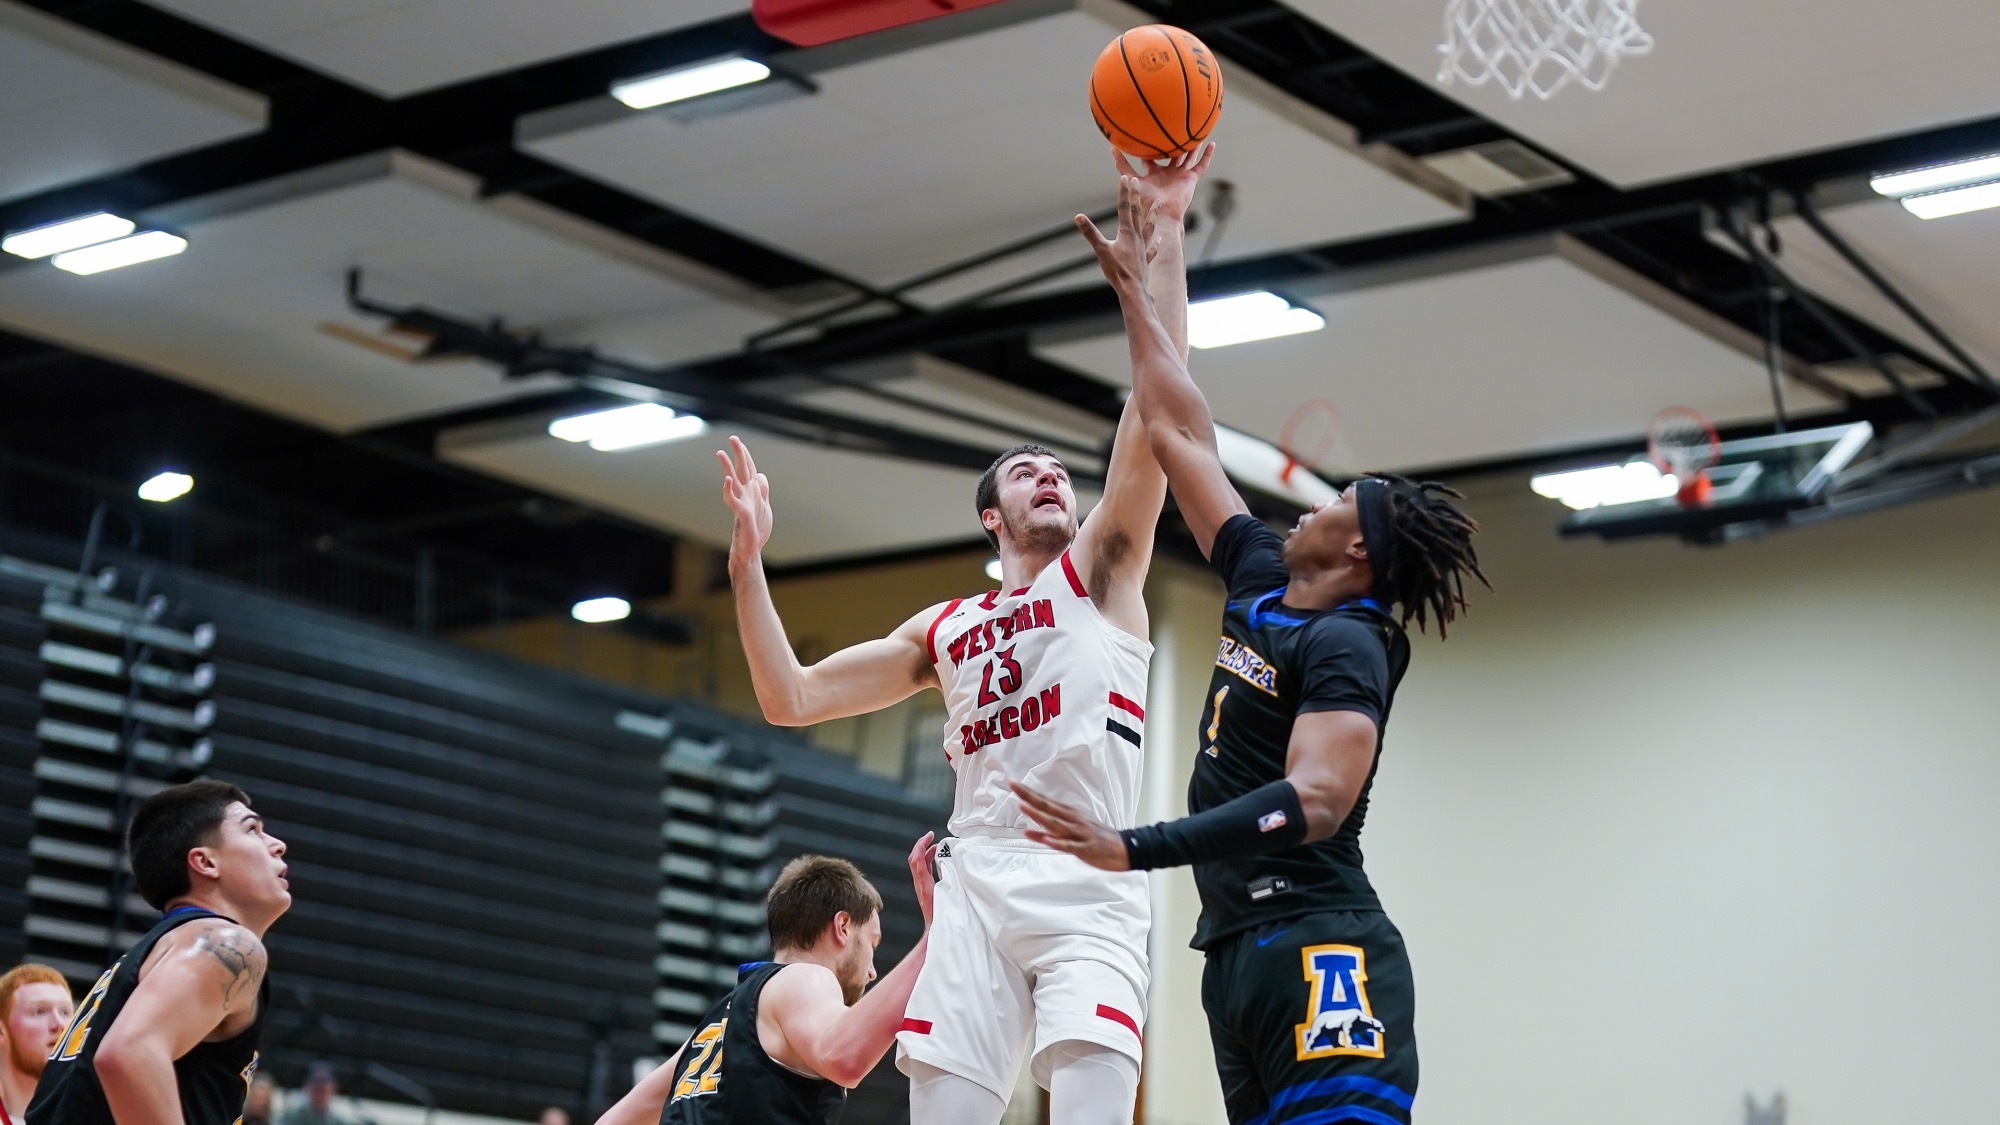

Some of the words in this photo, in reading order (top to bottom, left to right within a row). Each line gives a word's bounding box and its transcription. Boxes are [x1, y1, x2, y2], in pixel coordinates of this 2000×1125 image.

[1215, 635, 1279, 697] LASKA
[1275, 881, 1286, 889] M
[1295, 943, 1386, 1062] A
